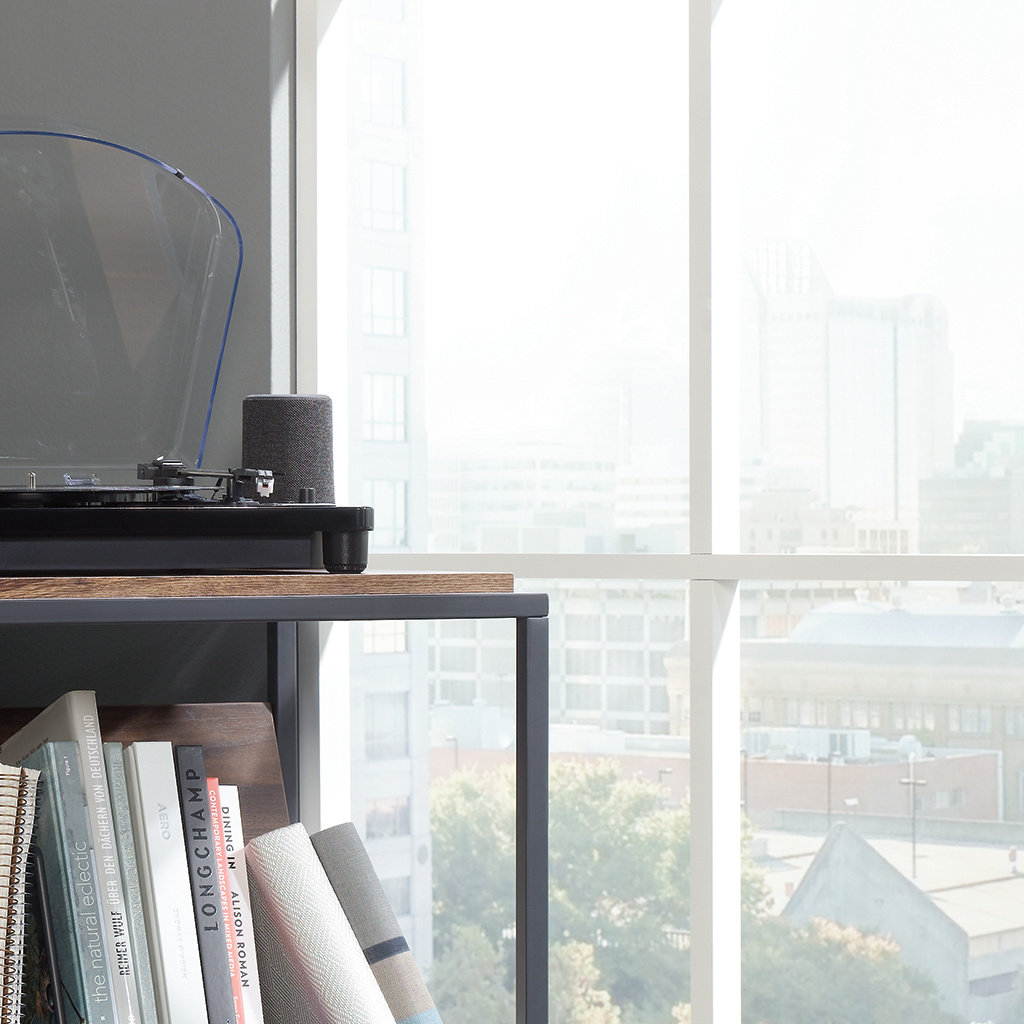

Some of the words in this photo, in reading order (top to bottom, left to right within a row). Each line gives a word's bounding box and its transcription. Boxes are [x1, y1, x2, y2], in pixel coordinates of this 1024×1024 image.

[83, 714, 103, 779] DEUTSCHLAND
[93, 784, 106, 804] VON
[93, 806, 111, 850] DÄCHERN
[157, 803, 171, 841] AERO
[221, 807, 234, 852] DINING
[104, 855, 116, 875] DEN
[186, 767, 219, 932] LONGCHAMP
[209, 790, 222, 857] CONTEMPORARY
[216, 859, 229, 911] LANDSCAPES
[224, 923, 233, 949] MIXED
[227, 856, 237, 869] IN
[72, 840, 95, 906] eclectic
[107, 880, 120, 905] ÜBER
[110, 911, 125, 938] WULF
[231, 891, 244, 937] ALISON
[81, 911, 103, 969] natural
[115, 941, 131, 976] REIMER
[237, 942, 250, 988] ROMAN
[92, 974, 108, 1003] the
